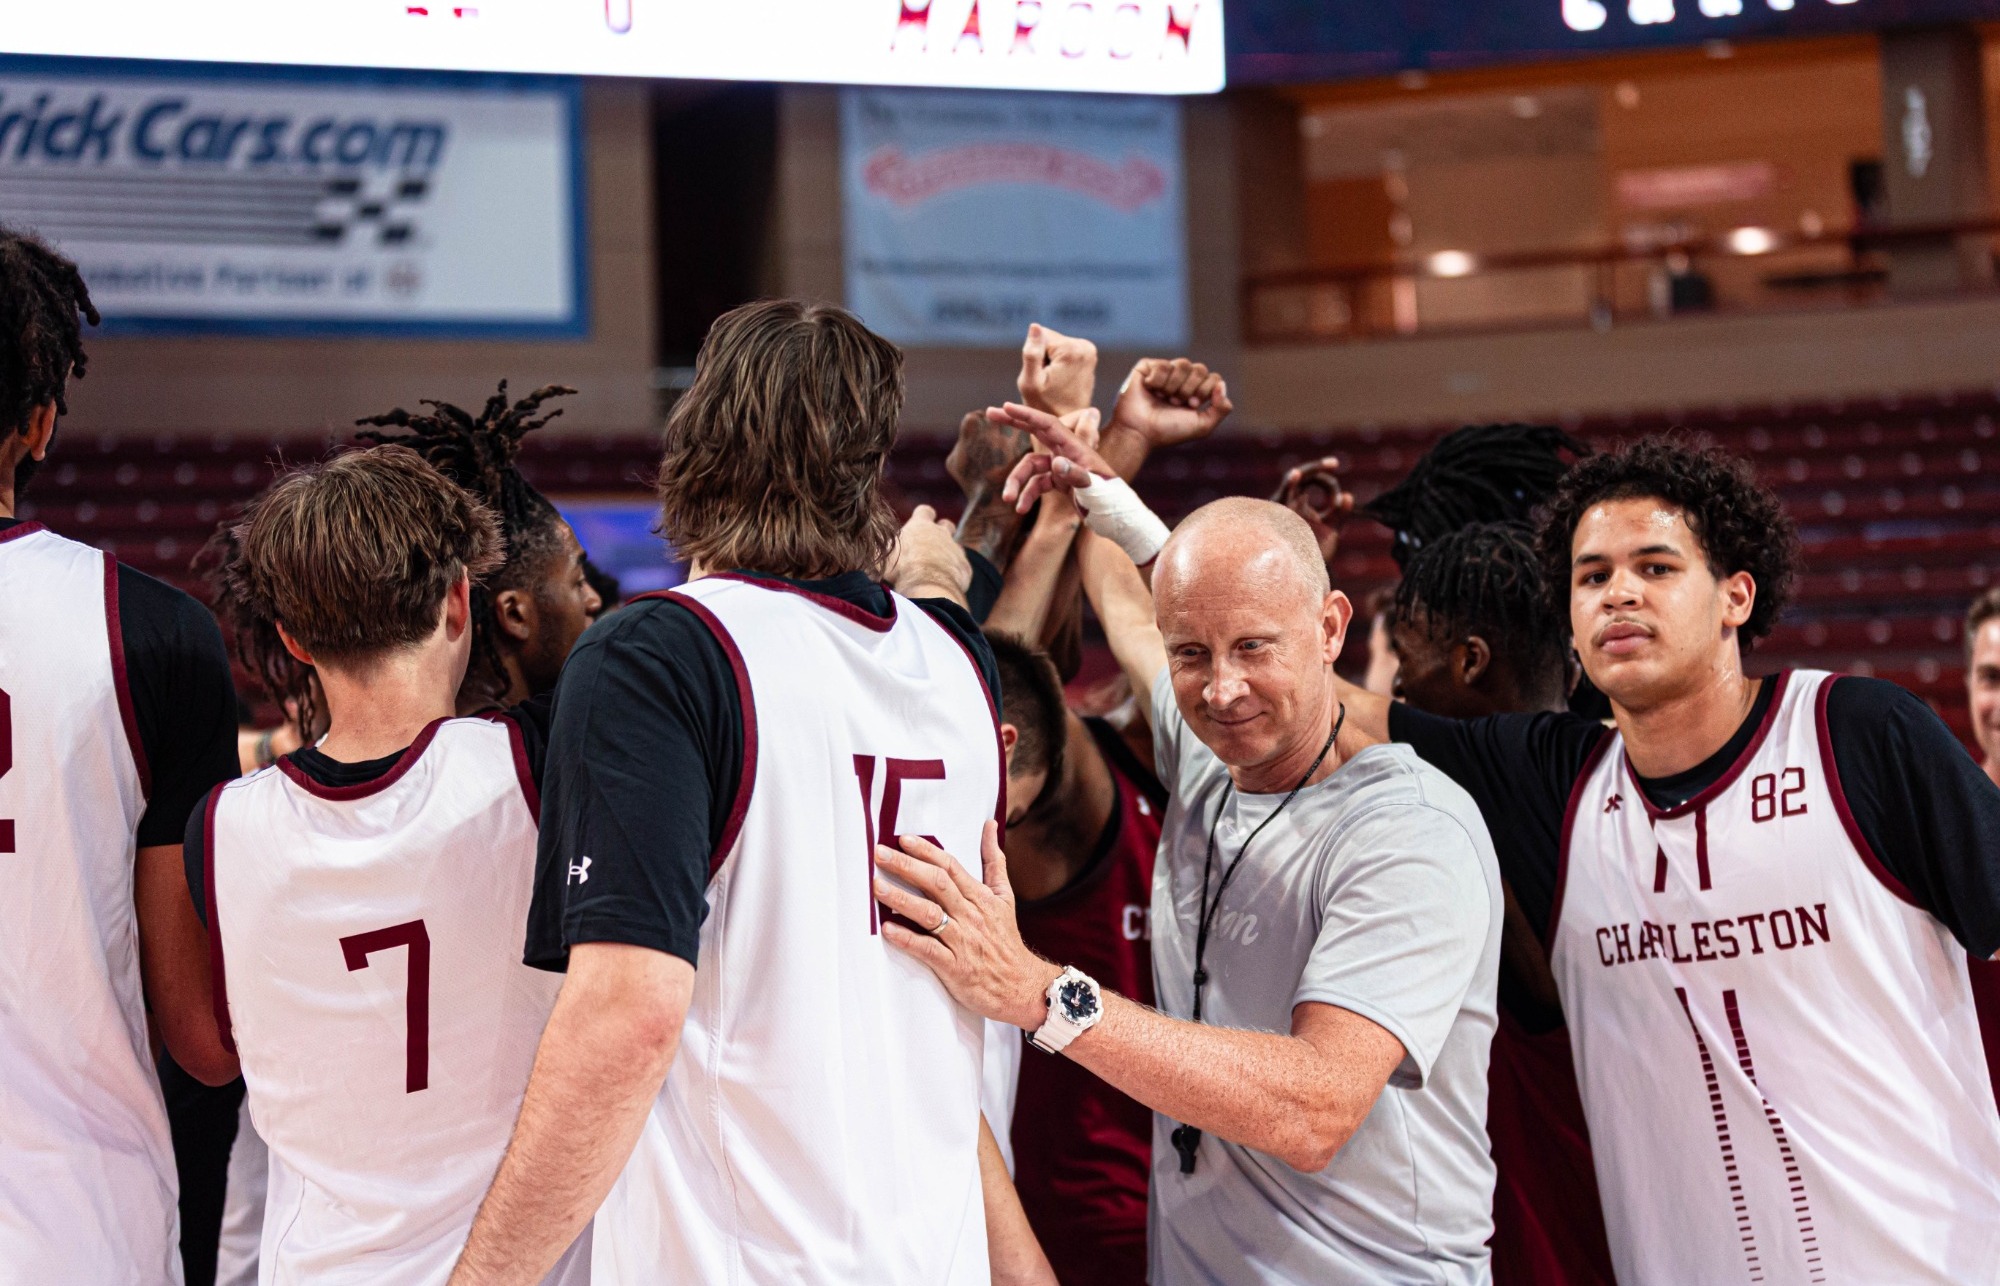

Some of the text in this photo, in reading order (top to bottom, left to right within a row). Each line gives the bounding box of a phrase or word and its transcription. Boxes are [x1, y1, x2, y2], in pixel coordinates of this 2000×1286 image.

[1752, 767, 1808, 824] 82
[1596, 903, 1831, 967] CHARLESTON
[339, 919, 431, 1094] 7
